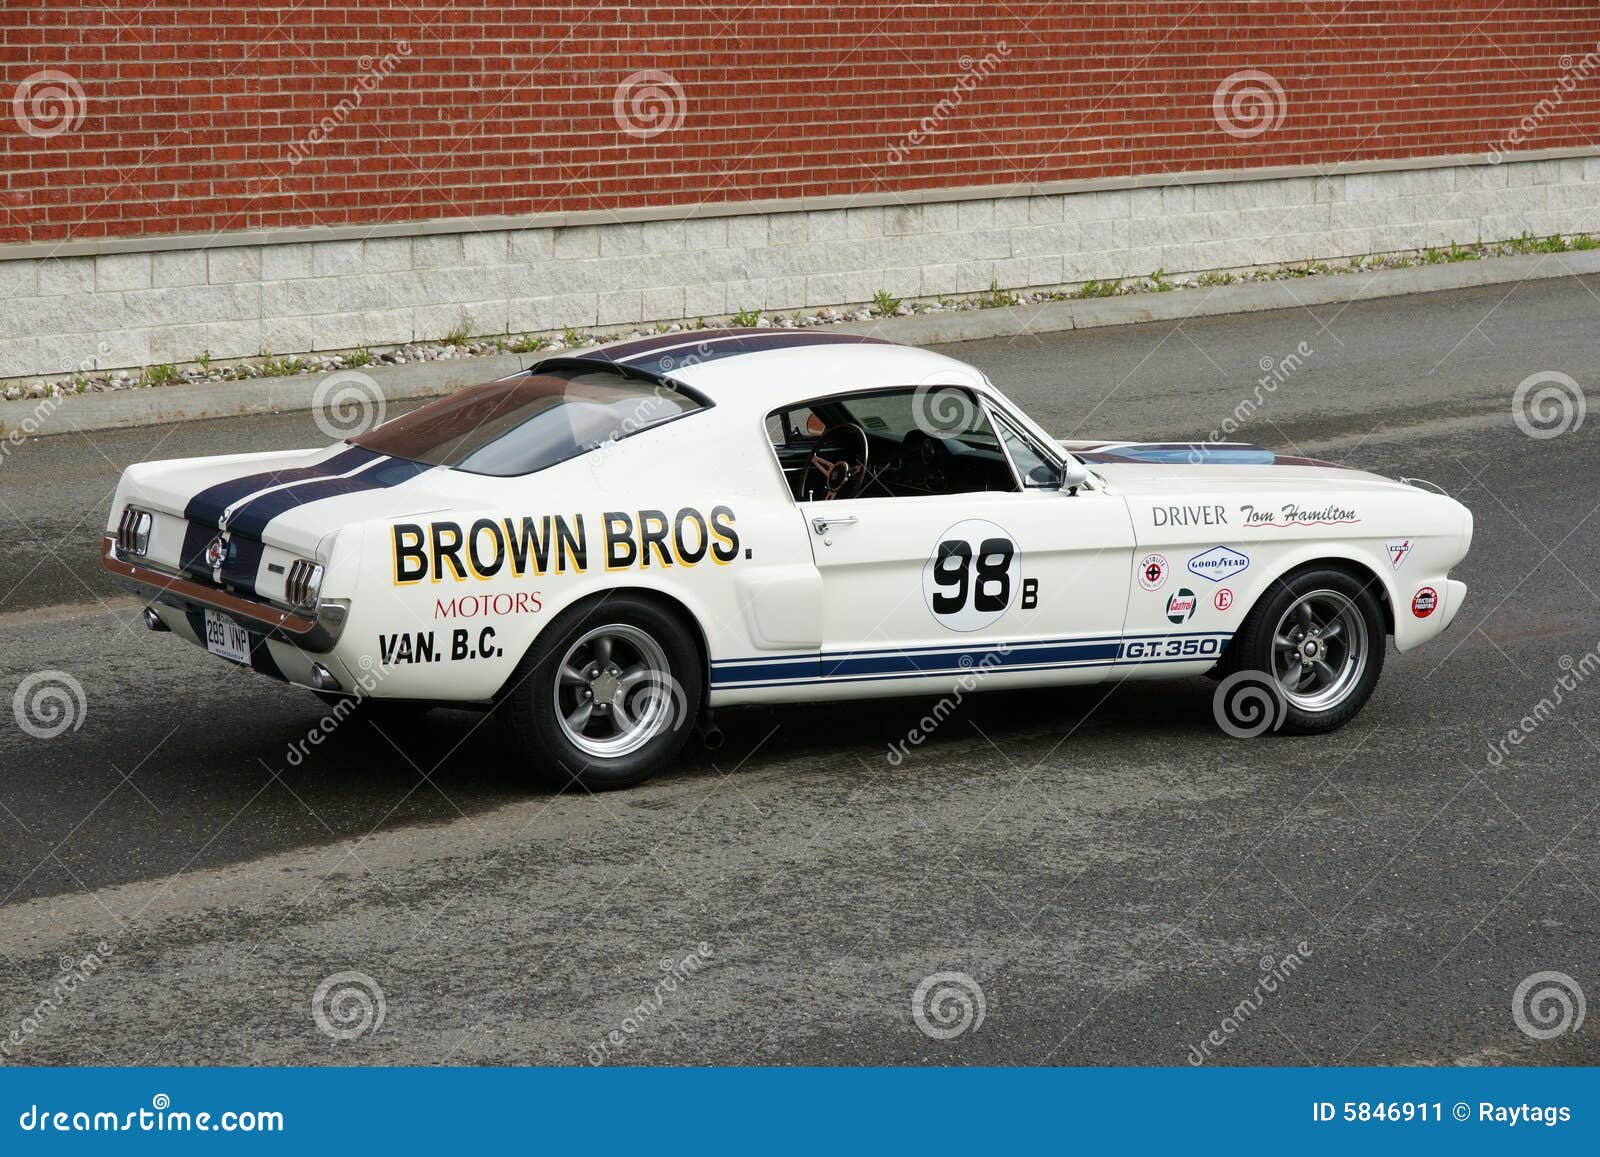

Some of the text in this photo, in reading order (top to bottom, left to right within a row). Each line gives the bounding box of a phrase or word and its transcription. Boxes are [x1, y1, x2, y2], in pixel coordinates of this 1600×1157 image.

[1151, 504, 1228, 527] DRIVER
[1239, 503, 1357, 523] Tom Hamilton
[390, 505, 753, 587] BROWN BROS.
[932, 537, 1039, 615] 98 B
[433, 591, 543, 620] MOTORS
[1170, 597, 1194, 612] Castrol
[206, 618, 247, 653] 289 VNP
[378, 626, 504, 666] VAN. B.C.
